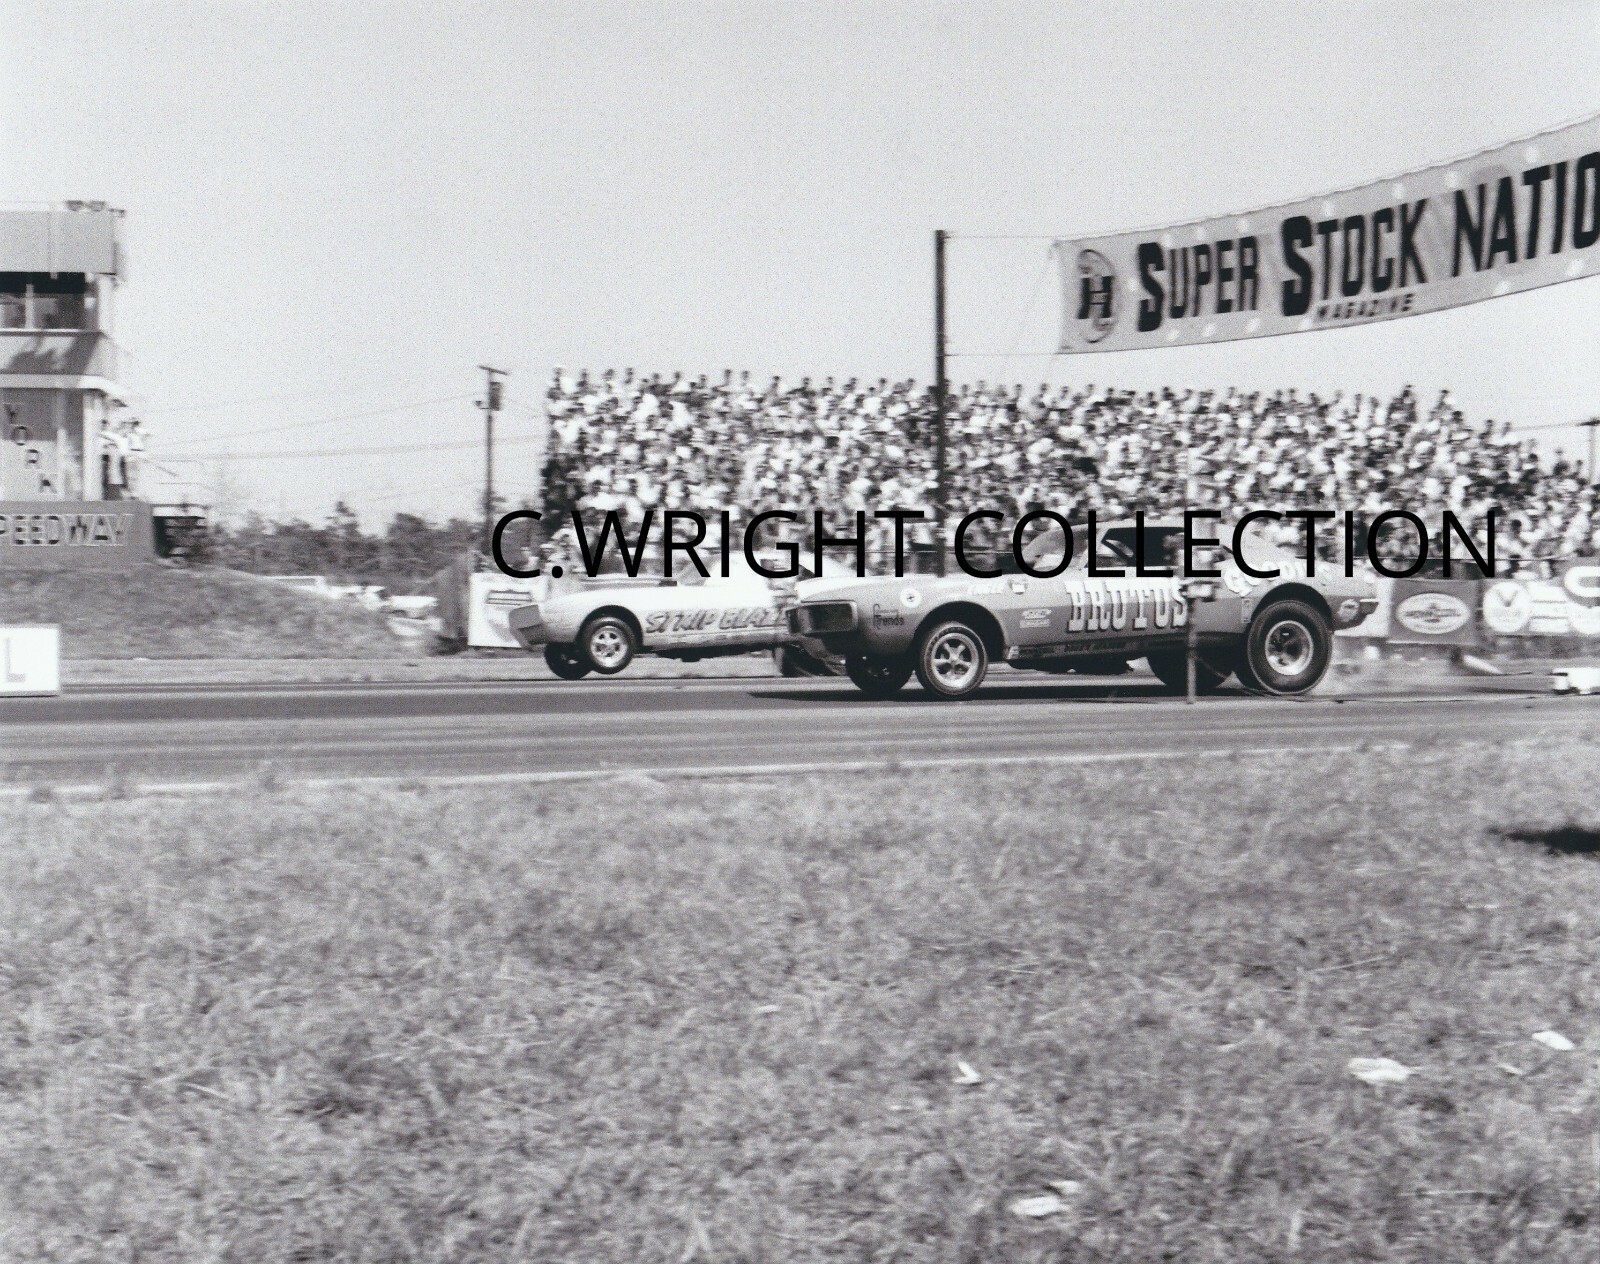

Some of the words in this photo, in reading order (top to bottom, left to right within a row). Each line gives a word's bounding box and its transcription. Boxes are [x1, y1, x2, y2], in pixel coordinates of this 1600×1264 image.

[1138, 236, 1260, 333] SUPER
[1281, 198, 1429, 317] STOCK
[1316, 292, 1415, 320] MAGAZINE
[1066, 578, 1189, 632] BRUTUS
